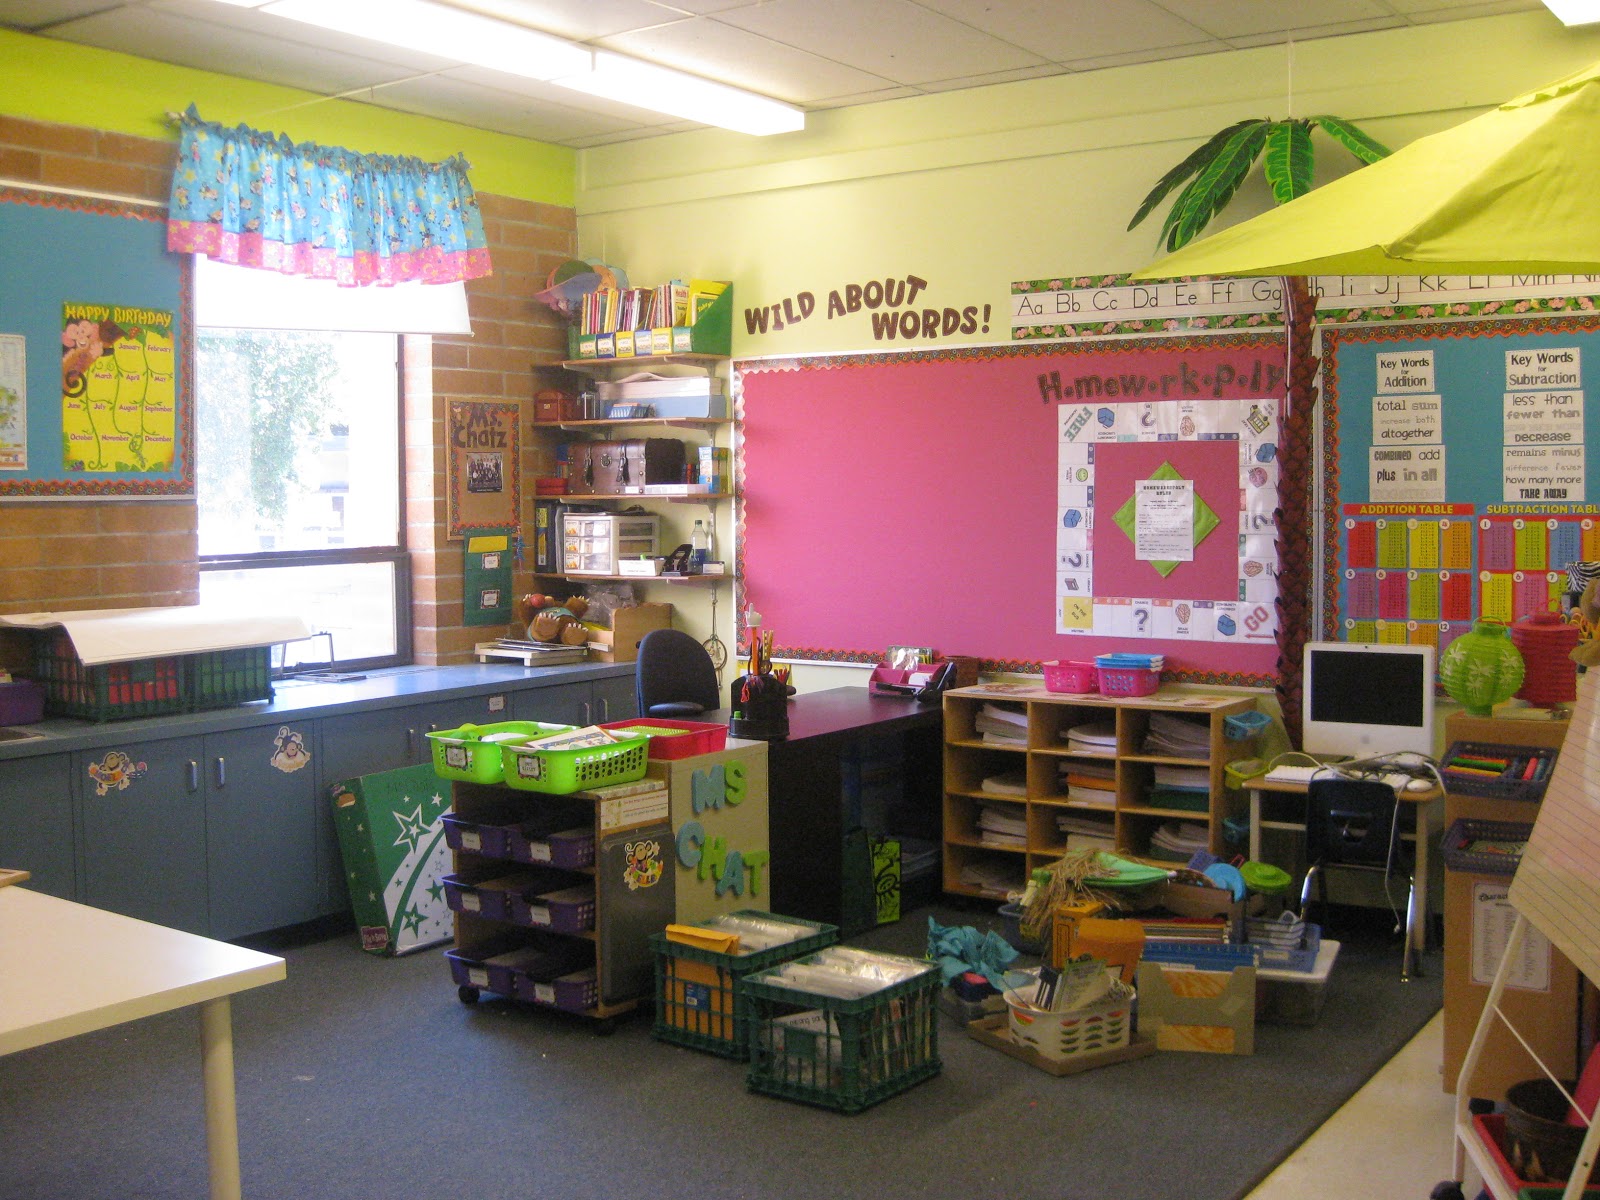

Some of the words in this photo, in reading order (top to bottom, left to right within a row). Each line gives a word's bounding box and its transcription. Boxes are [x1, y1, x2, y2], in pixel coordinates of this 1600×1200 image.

[1018, 296, 1043, 316] Aa
[1056, 293, 1081, 313] Bb
[1092, 291, 1118, 311] Cc
[1133, 288, 1158, 309] Dd
[1175, 284, 1197, 306] Ee
[1211, 282, 1235, 304] Ff
[1252, 280, 1282, 310] Gg
[745, 291, 815, 335] WILD
[827, 274, 928, 320] ABOUT
[65, 305, 109, 322] HAPPY
[114, 307, 171, 328] BIRTHDAY
[871, 303, 992, 341] WORDS!
[118, 343, 141, 351] January
[147, 344, 171, 353] February
[1380, 359, 1397, 370] Key
[1400, 358, 1430, 368] Words
[1511, 354, 1532, 367] Key
[1537, 352, 1573, 364] Words
[126, 373, 140, 381] April
[154, 375, 166, 383] May
[1384, 376, 1427, 388] Addition
[1509, 372, 1577, 386] Subtraction
[1377, 400, 1406, 411] total
[1412, 402, 1438, 410] sum
[1513, 394, 1536, 406] less
[1544, 393, 1573, 405] than
[94, 403, 106, 411] July
[119, 404, 138, 412] August
[144, 405, 173, 413] September
[1506, 410, 1544, 419] fewer
[1552, 409, 1580, 418] than
[466, 406, 503, 429] Ms.
[1415, 415, 1436, 424] both
[1063, 406, 1093, 442] FREE
[101, 434, 129, 442] November
[453, 426, 508, 449] Chatz
[1381, 428, 1434, 440] altogether
[1419, 449, 1440, 460] add
[1506, 449, 1546, 457] remains
[1552, 447, 1581, 457] minus
[1377, 469, 1396, 483] plus
[1403, 468, 1417, 481] in
[1421, 468, 1437, 481] all
[1505, 476, 1525, 484] how
[1528, 476, 1554, 485] many
[1557, 476, 1581, 484] more
[1360, 504, 1417, 514] ADDITION
[1418, 504, 1454, 514] TABLE
[1486, 504, 1568, 514] SUBTRACTION
[1571, 504, 1600, 514] TABL
[1243, 605, 1270, 632] GO
[1438, 623, 1448, 631] 12
[692, 759, 748, 814] MS
[675, 821, 771, 897] CHAT
